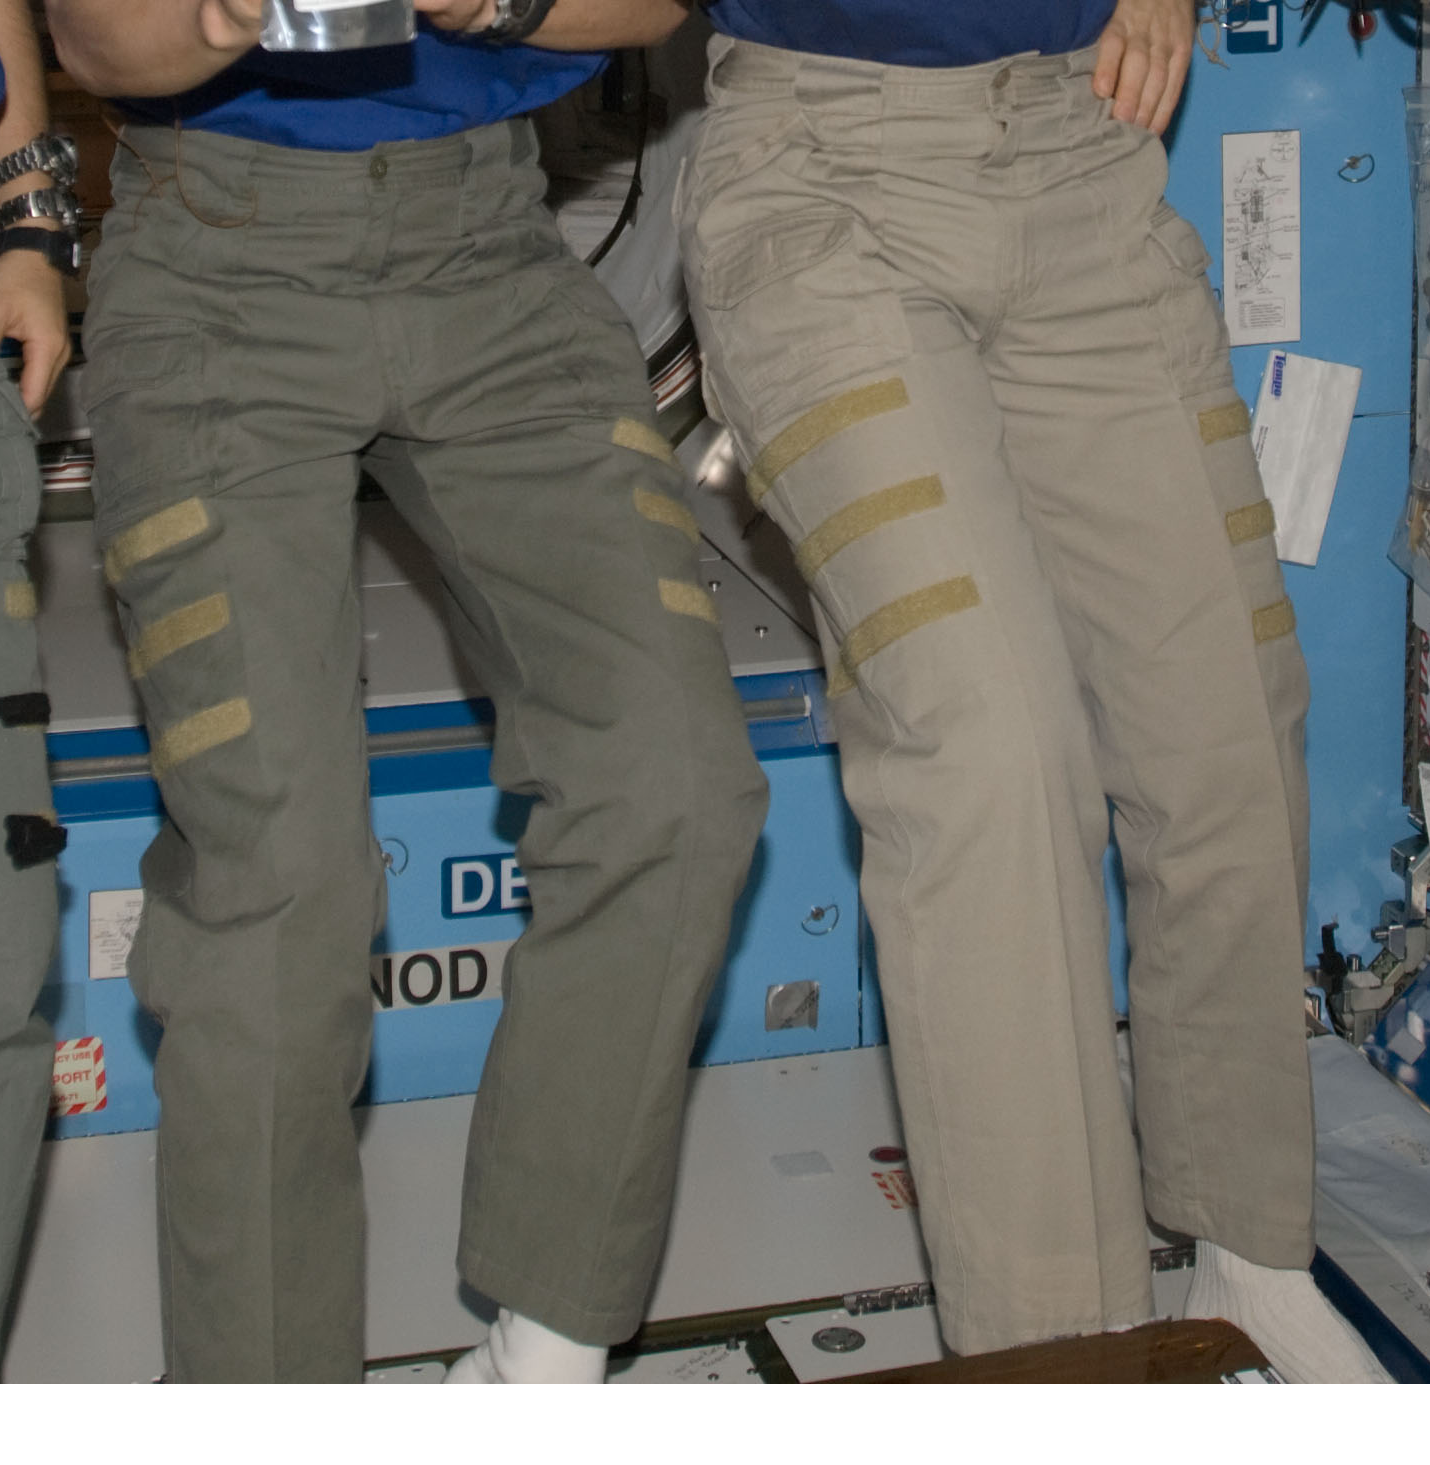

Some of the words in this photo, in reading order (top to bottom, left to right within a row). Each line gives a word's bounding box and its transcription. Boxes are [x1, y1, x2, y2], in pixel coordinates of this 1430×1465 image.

[1272, 352, 1287, 402] Tempo
[451, 857, 533, 914] DE
[72, 1050, 92, 1062] USE
[53, 1069, 92, 1086] PORT
